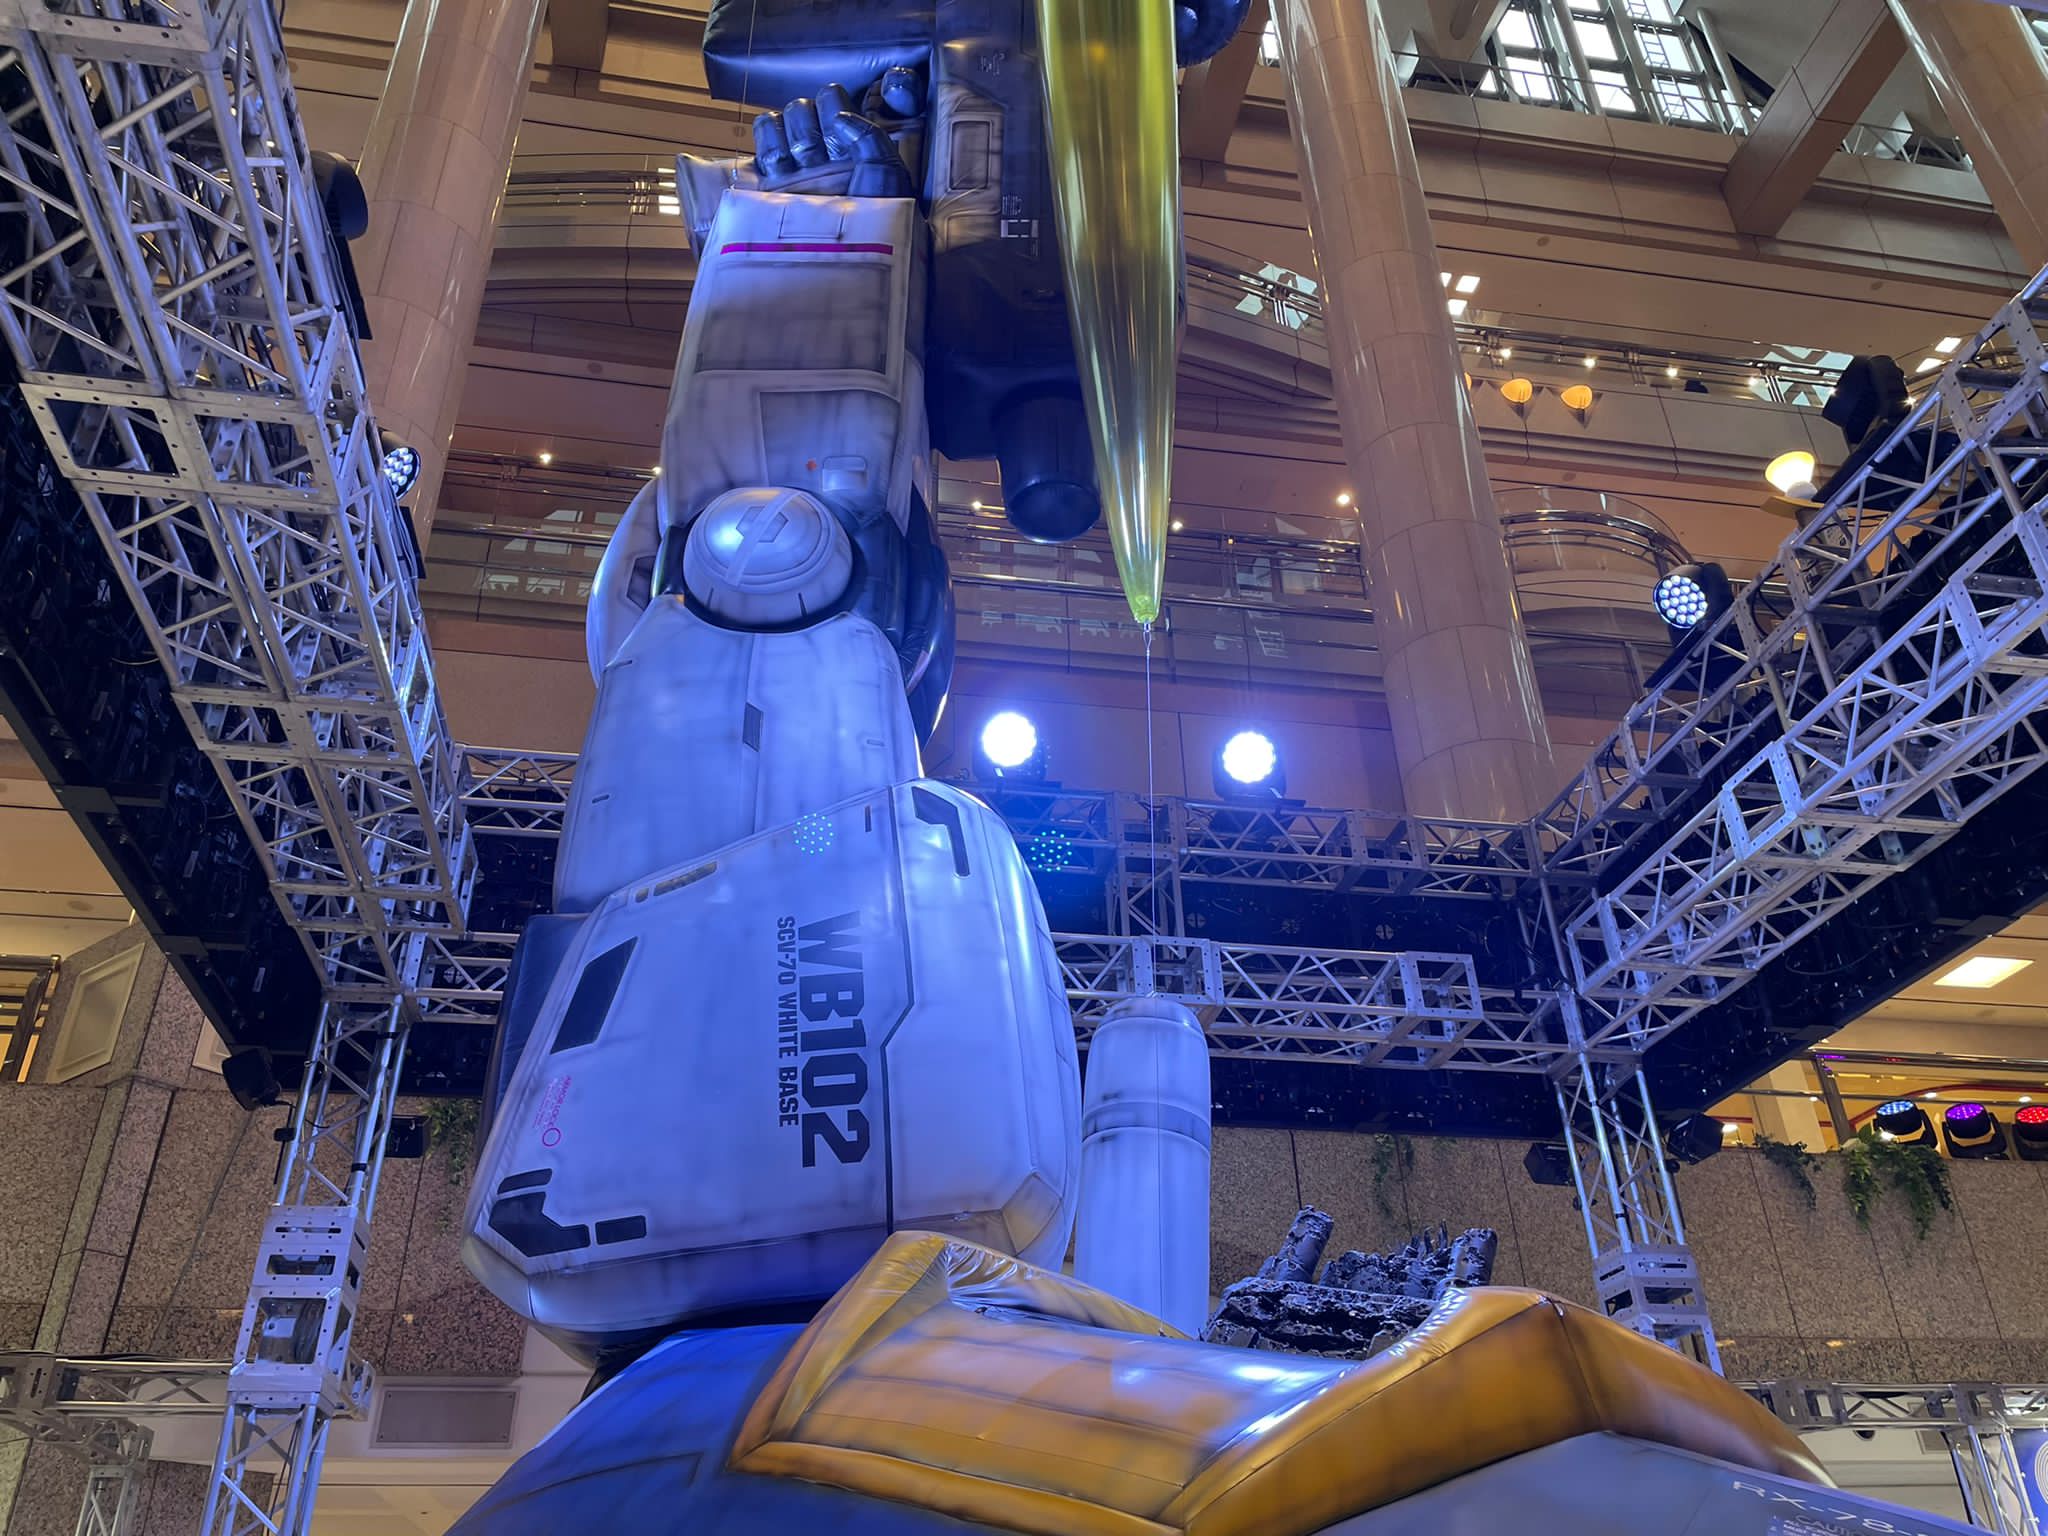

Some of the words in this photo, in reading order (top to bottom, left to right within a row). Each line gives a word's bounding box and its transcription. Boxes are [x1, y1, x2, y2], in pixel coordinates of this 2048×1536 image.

[777, 916, 796, 985] SCV-70
[778, 991, 798, 1059] WHITE
[798, 910, 870, 1168] WB102
[779, 1066, 799, 1127] BASE
[1733, 1481, 1929, 1536] RX-78-
